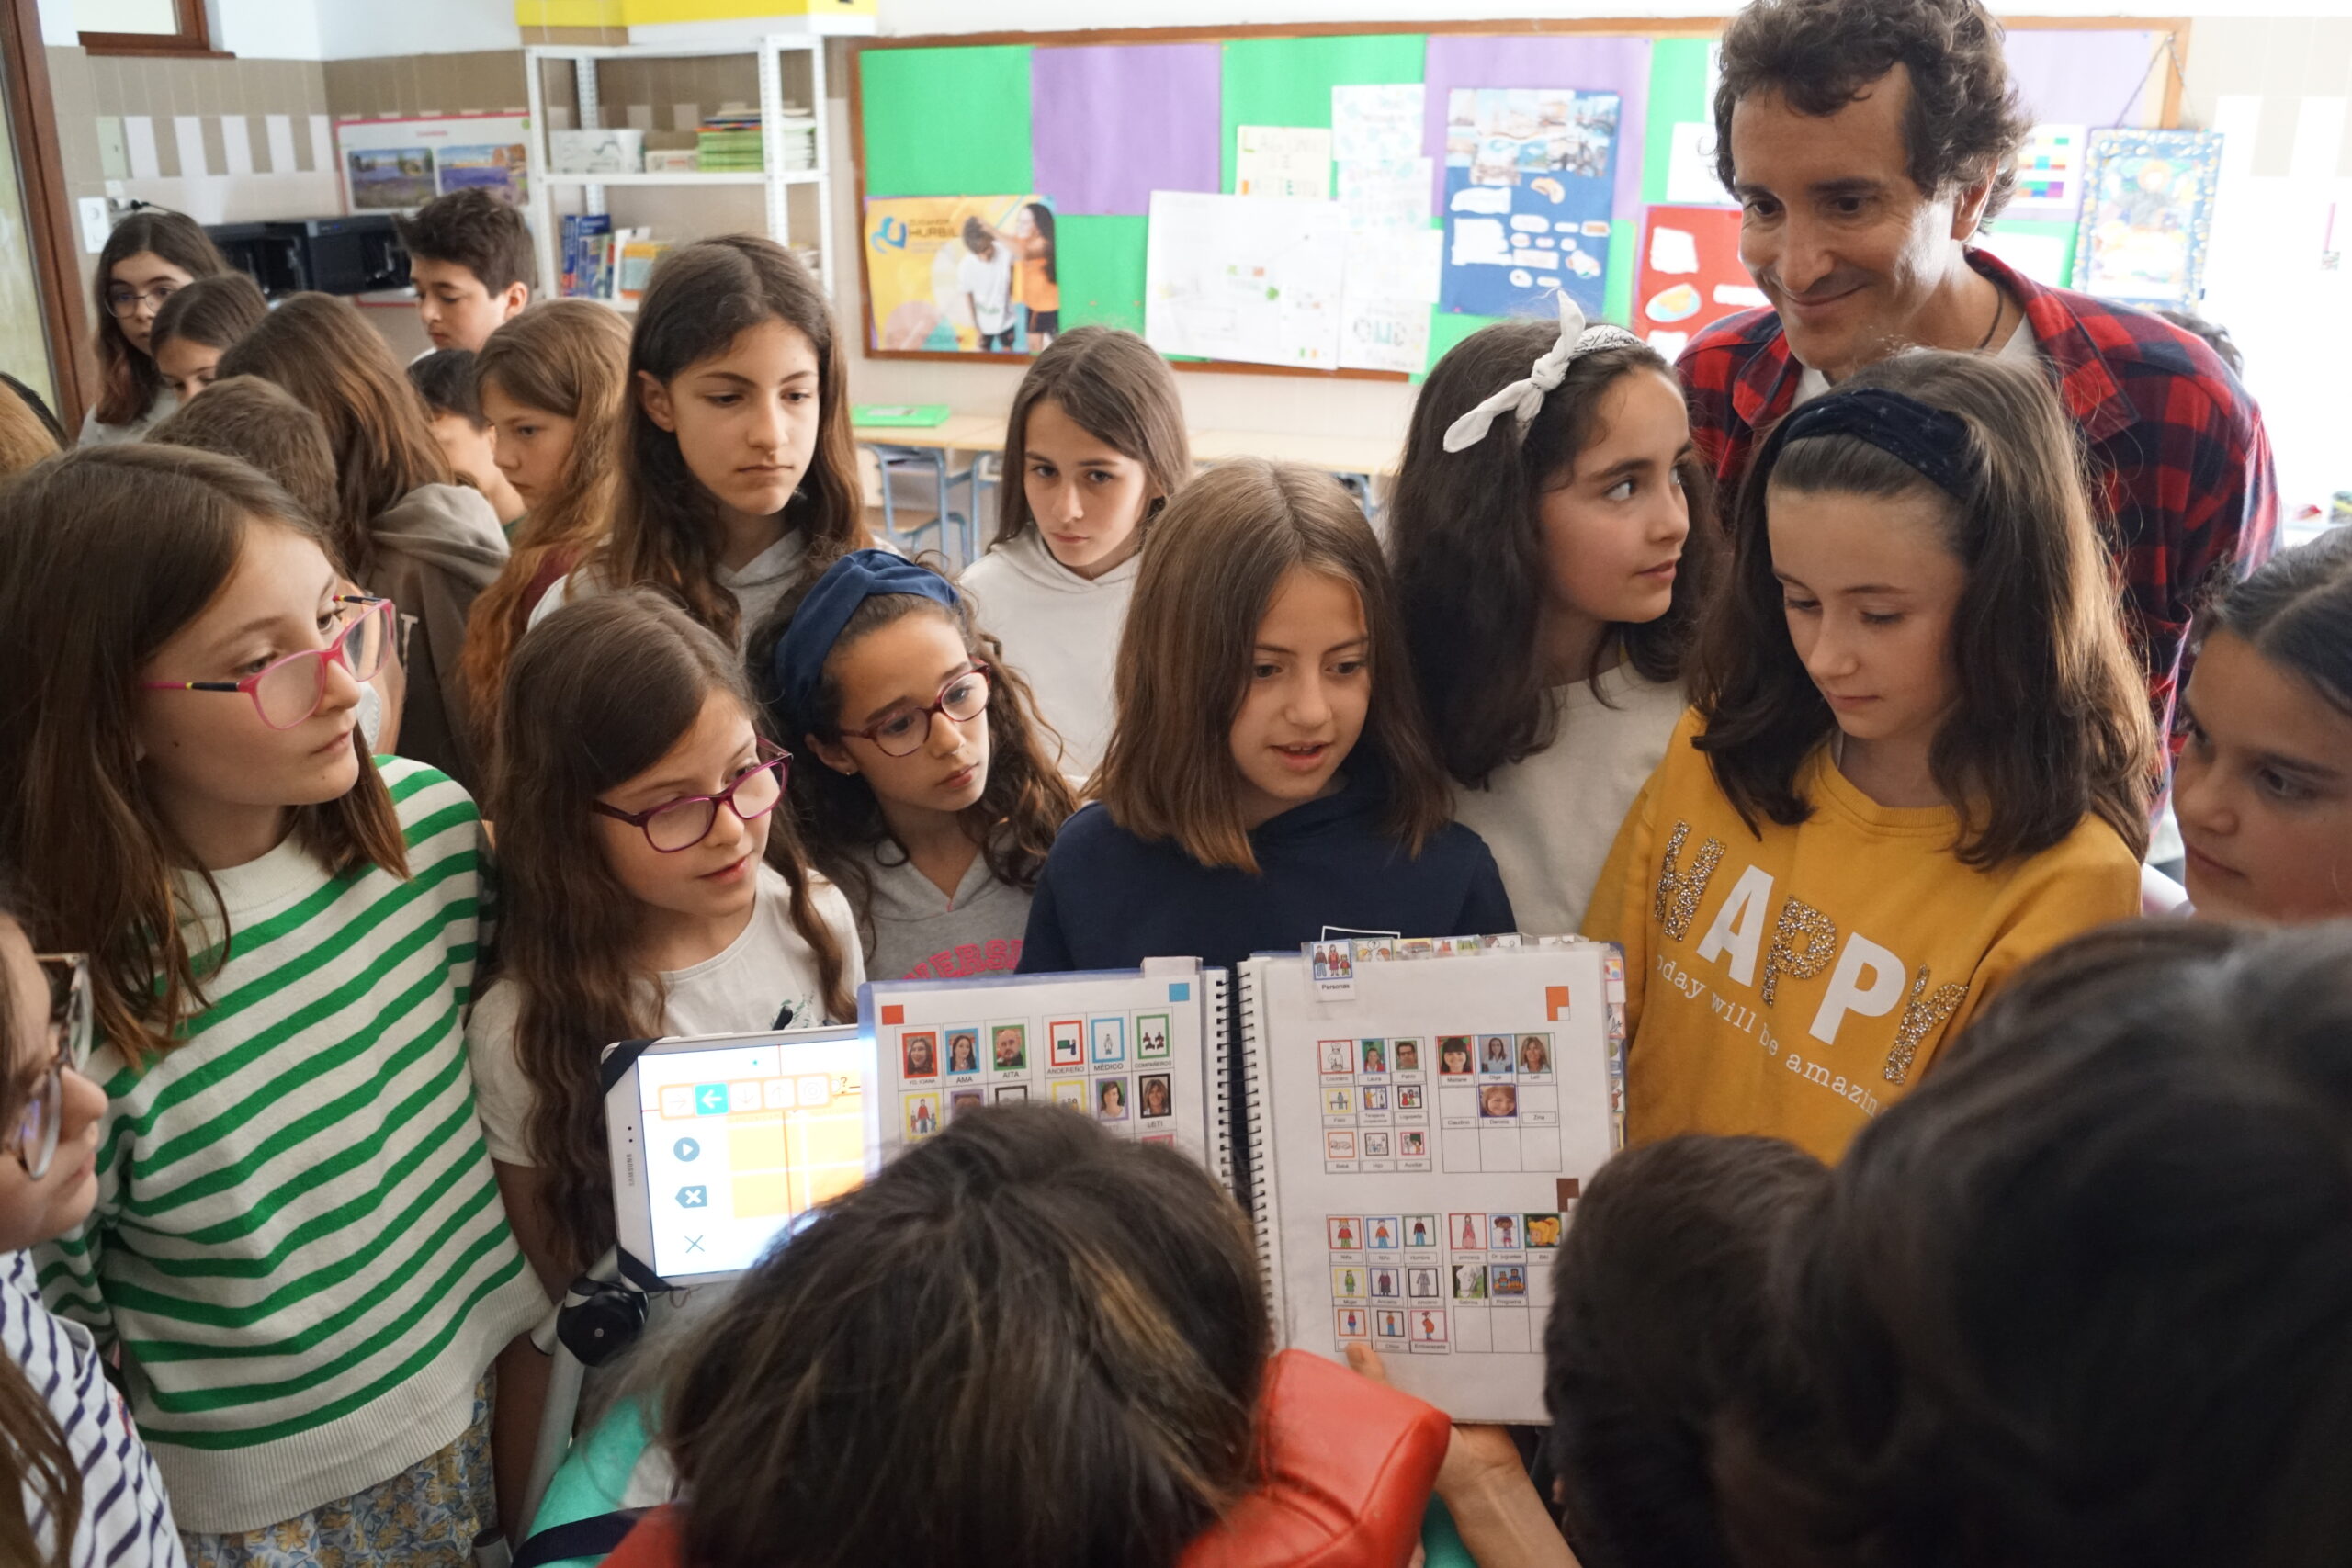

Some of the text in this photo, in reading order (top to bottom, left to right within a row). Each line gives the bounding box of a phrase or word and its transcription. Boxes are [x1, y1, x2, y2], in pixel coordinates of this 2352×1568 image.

[1654, 820, 1968, 1085] HAPPY
[1134, 1060, 1172, 1068] COMPAÑEROS
[1711, 992, 1757, 1033] will
[1759, 1022, 1780, 1056] be
[1785, 1053, 1881, 1118] amazin
[1046, 1066, 1085, 1075] ANDEREÑO
[1093, 1063, 1124, 1072] MÉDICO
[626, 1153, 635, 1187] SAMSUNG
